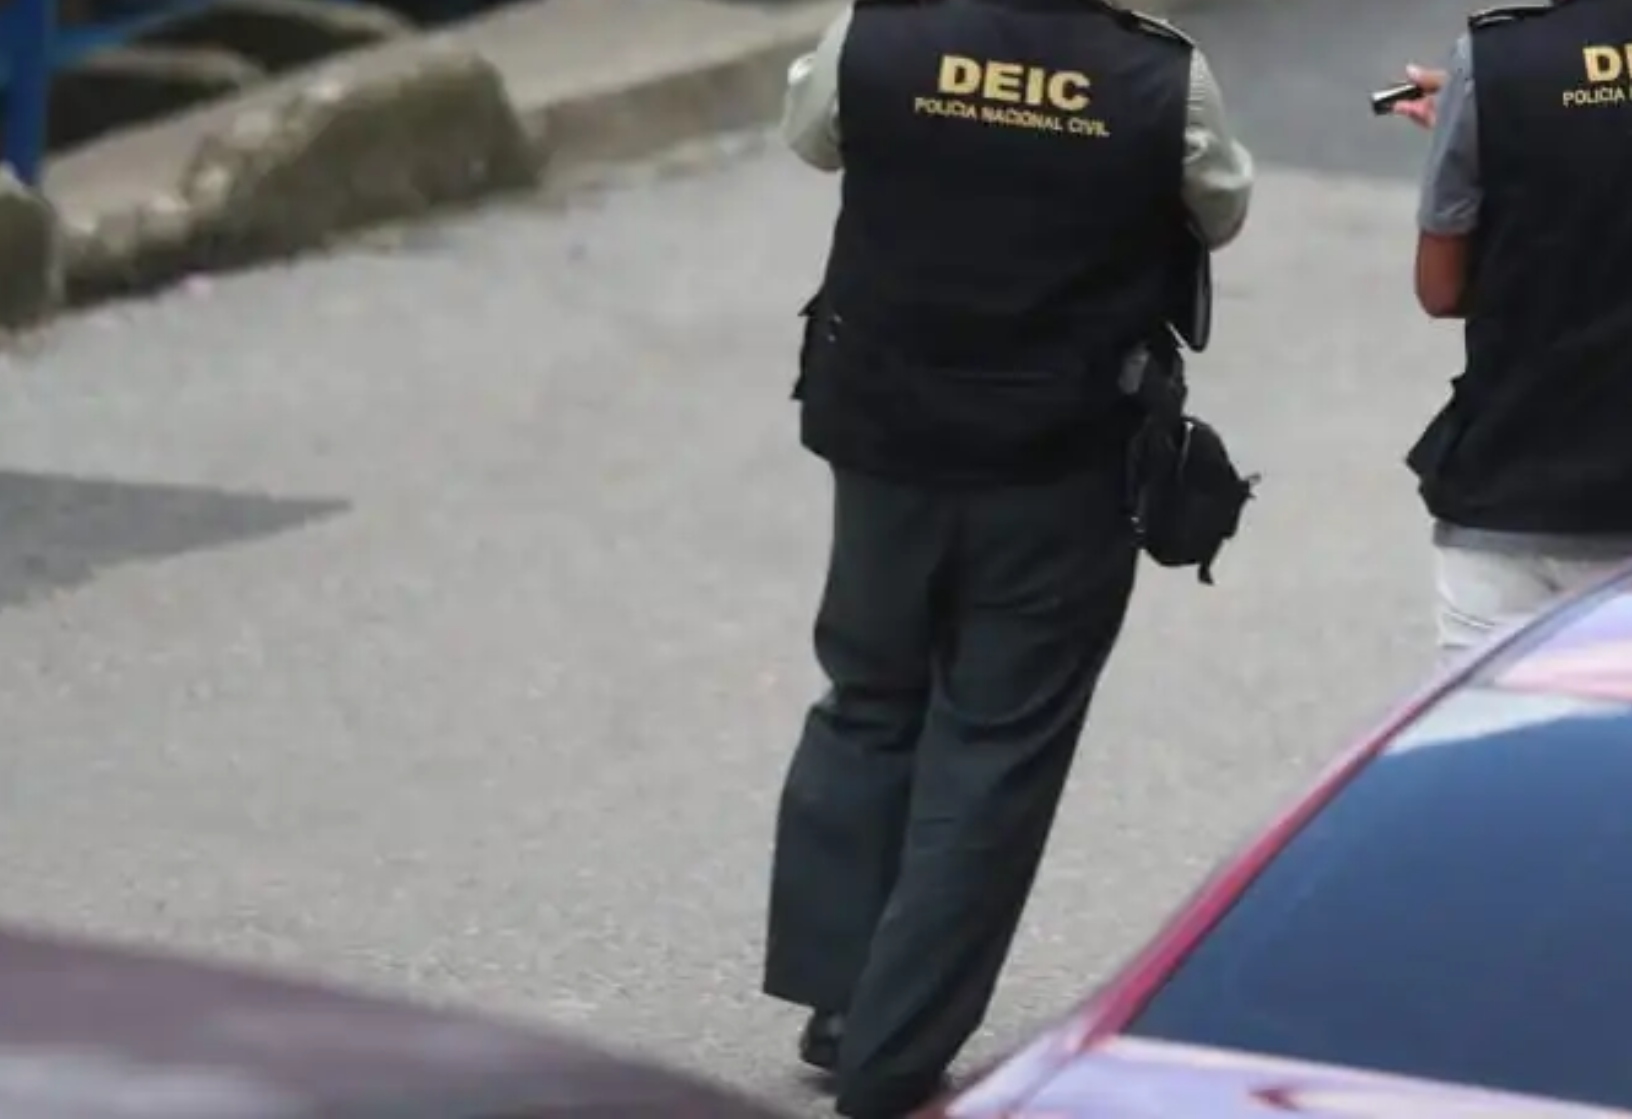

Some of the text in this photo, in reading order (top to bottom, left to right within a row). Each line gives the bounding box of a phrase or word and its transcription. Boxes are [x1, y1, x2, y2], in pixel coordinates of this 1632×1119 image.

[937, 54, 1091, 111] DEIC
[1562, 86, 1625, 107] POLICIA
[914, 97, 1111, 138] POLICIA NACIONAL CIVIL
